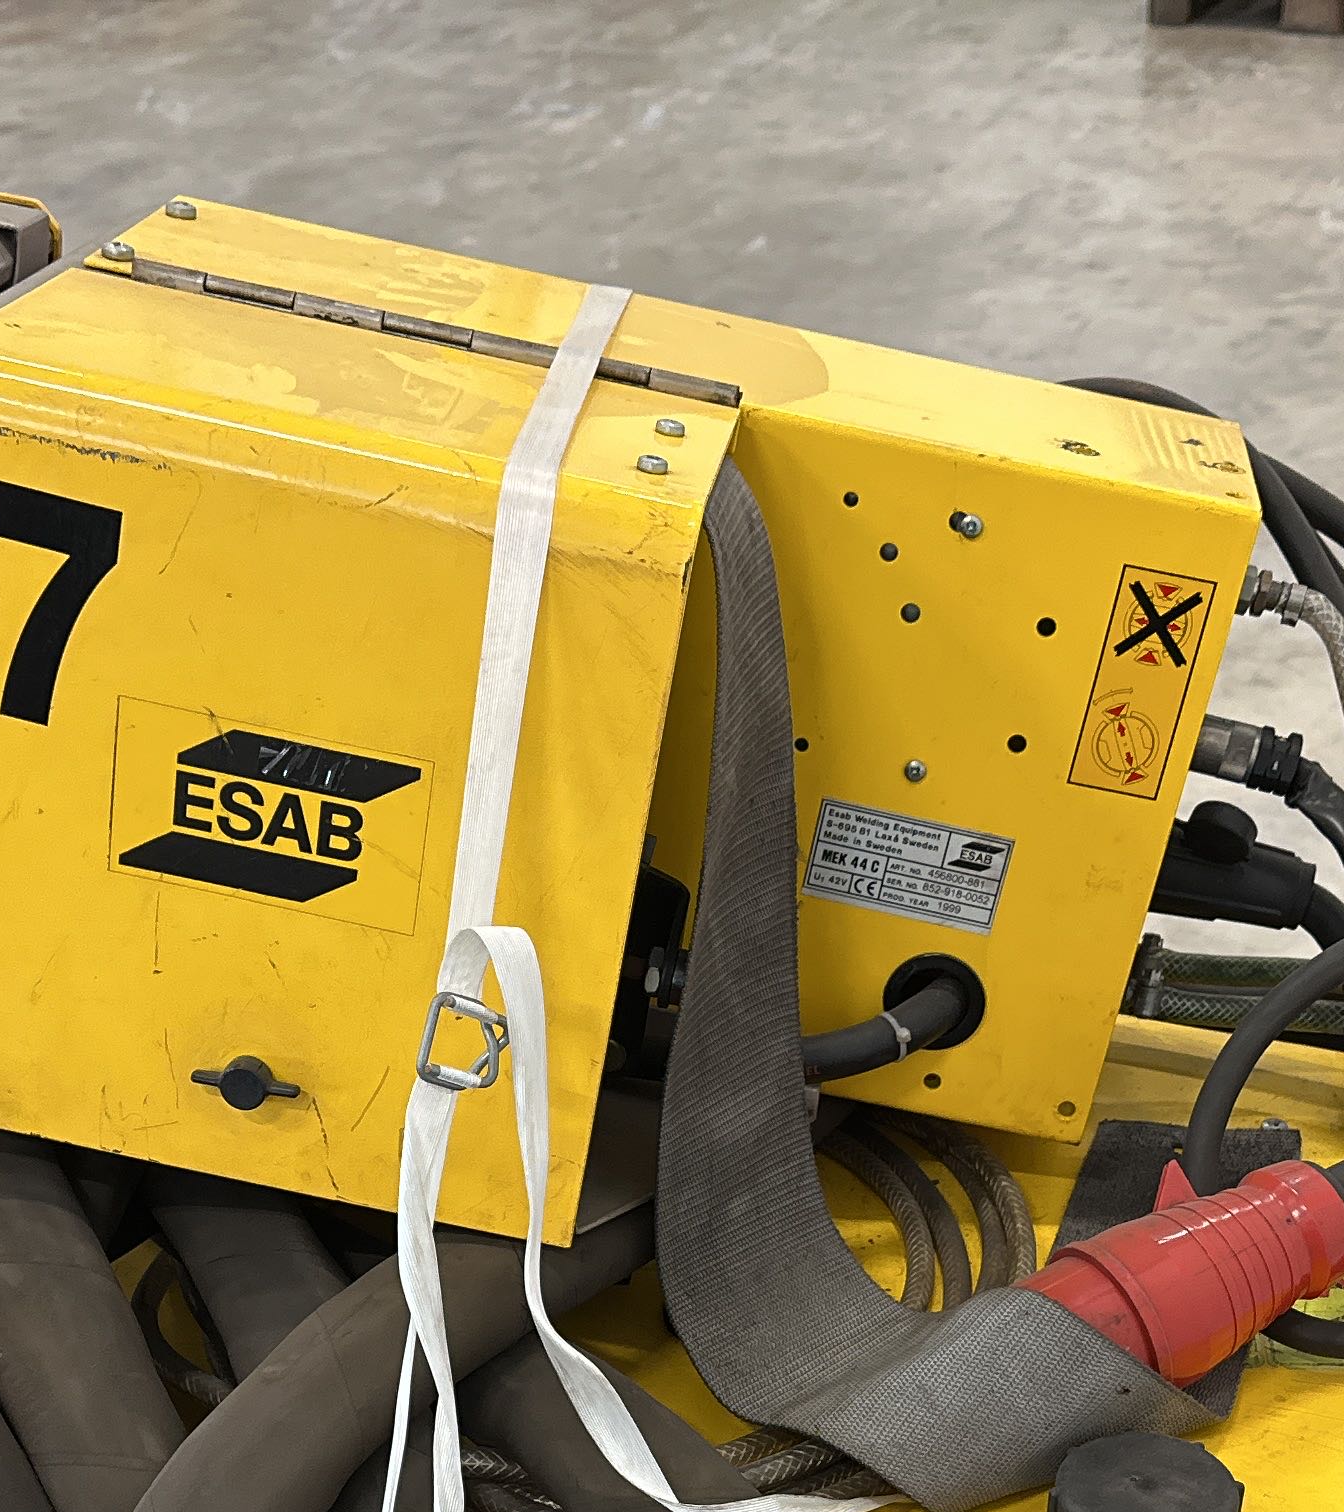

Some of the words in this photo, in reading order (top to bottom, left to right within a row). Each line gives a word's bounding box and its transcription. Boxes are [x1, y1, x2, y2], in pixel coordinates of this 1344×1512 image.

[172, 769, 364, 862] ESAB
[828, 808, 852, 820] Esab
[855, 814, 890, 831] Welding
[893, 824, 942, 841] Equipment
[823, 830, 849, 843] Made
[853, 837, 862, 846] in
[865, 840, 903, 856] Sweden
[902, 837, 939, 852] Sweden
[821, 849, 848, 867] MEK
[850, 856, 868, 871] 44
[870, 860, 880, 873] C
[959, 849, 993, 865] ESAB
[828, 874, 848, 887] 42V
[909, 898, 929, 908] YEAR
[937, 901, 962, 914] 1999
